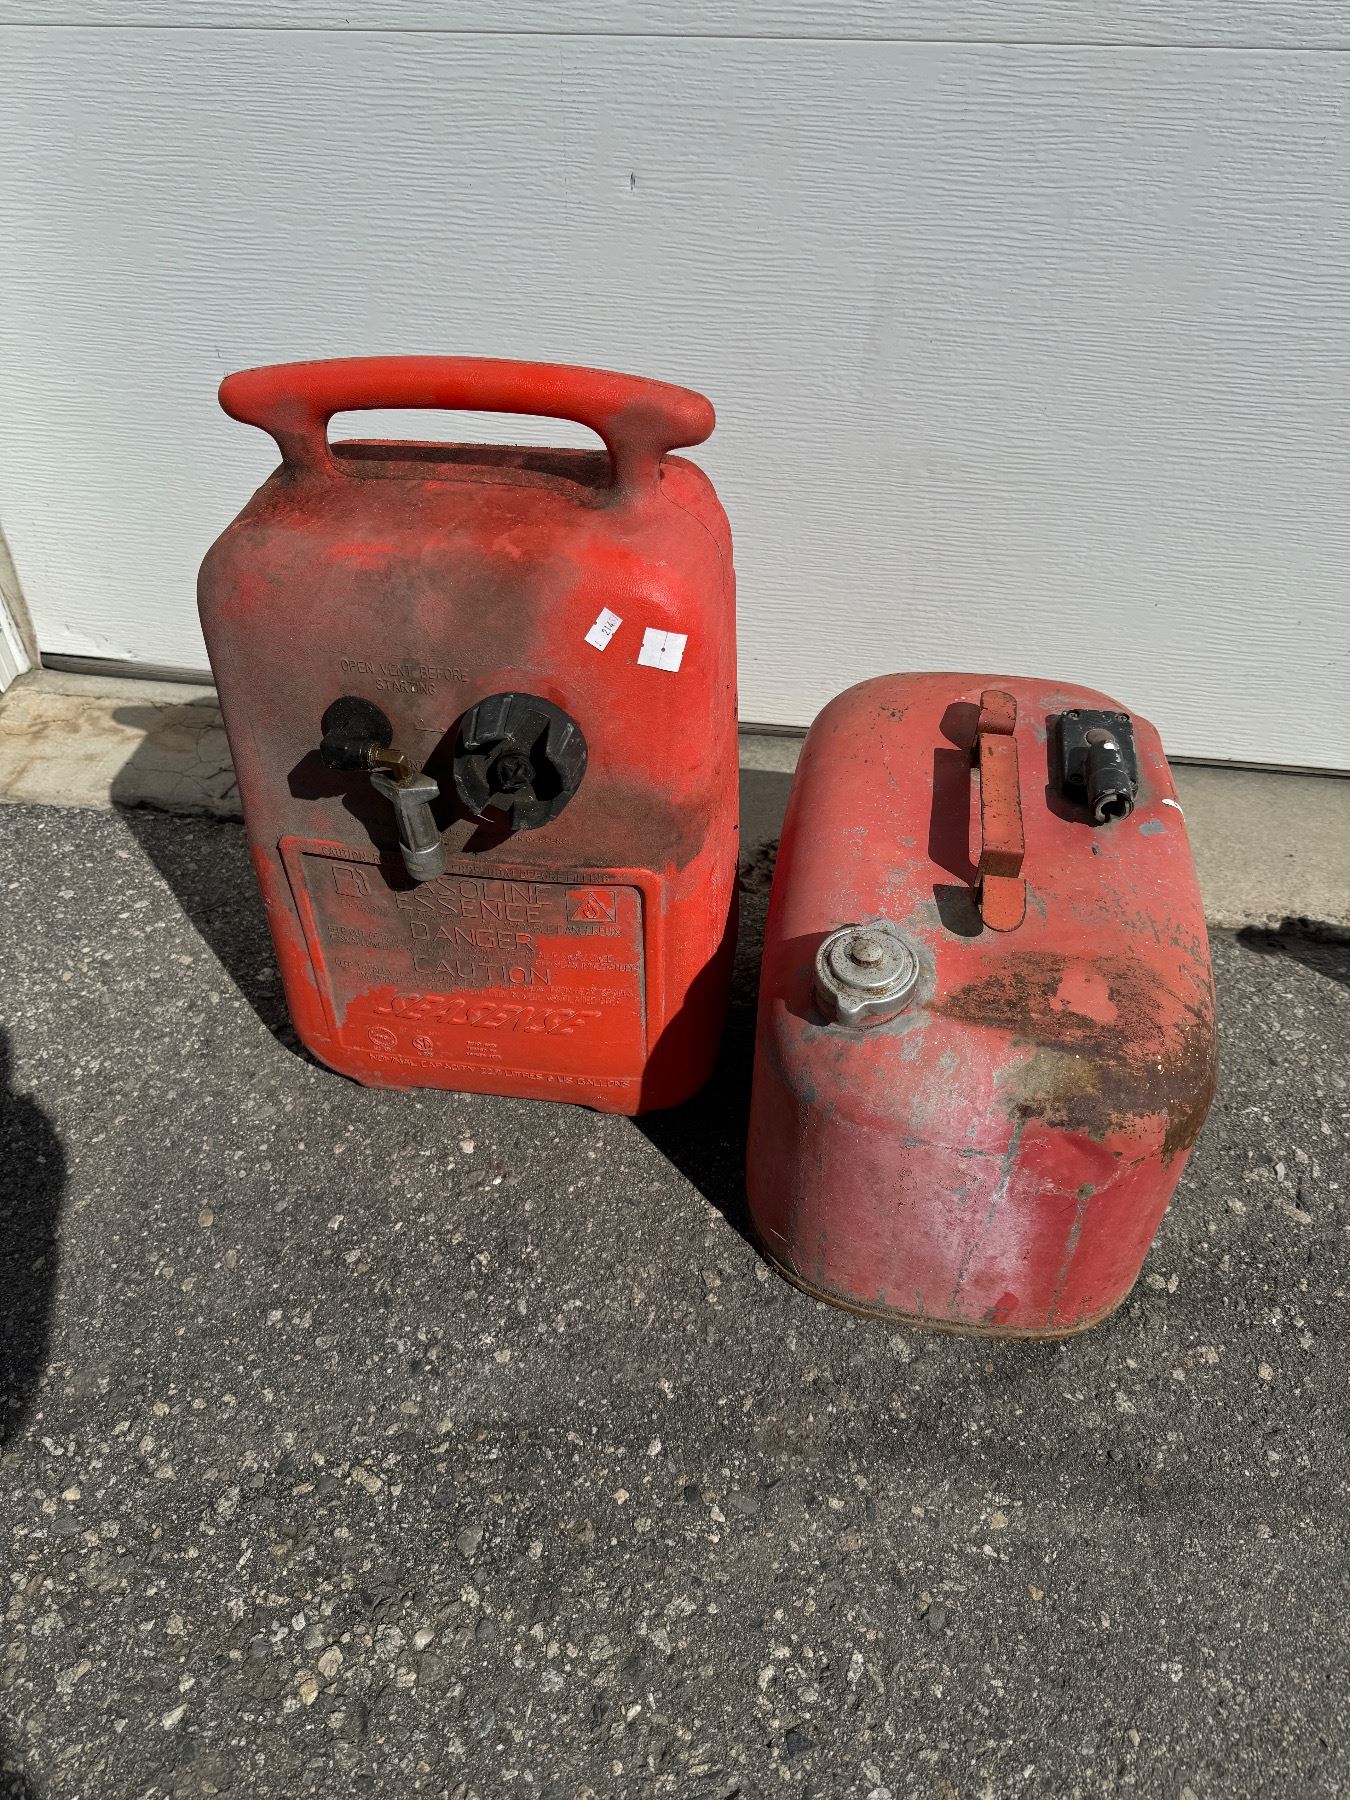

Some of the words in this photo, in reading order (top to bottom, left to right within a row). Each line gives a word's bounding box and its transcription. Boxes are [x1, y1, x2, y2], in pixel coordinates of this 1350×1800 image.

[340, 659, 374, 674] OPEN
[379, 663, 413, 678] VENT
[419, 665, 470, 683] BEFORE
[375, 679, 438, 697] STARTING
[414, 877, 553, 906] ASOLINE
[395, 891, 544, 924] ESSENCE
[410, 920, 534, 952] DANGER
[413, 954, 550, 986] CAUTION
[505, 1071, 544, 1082] LITRES
